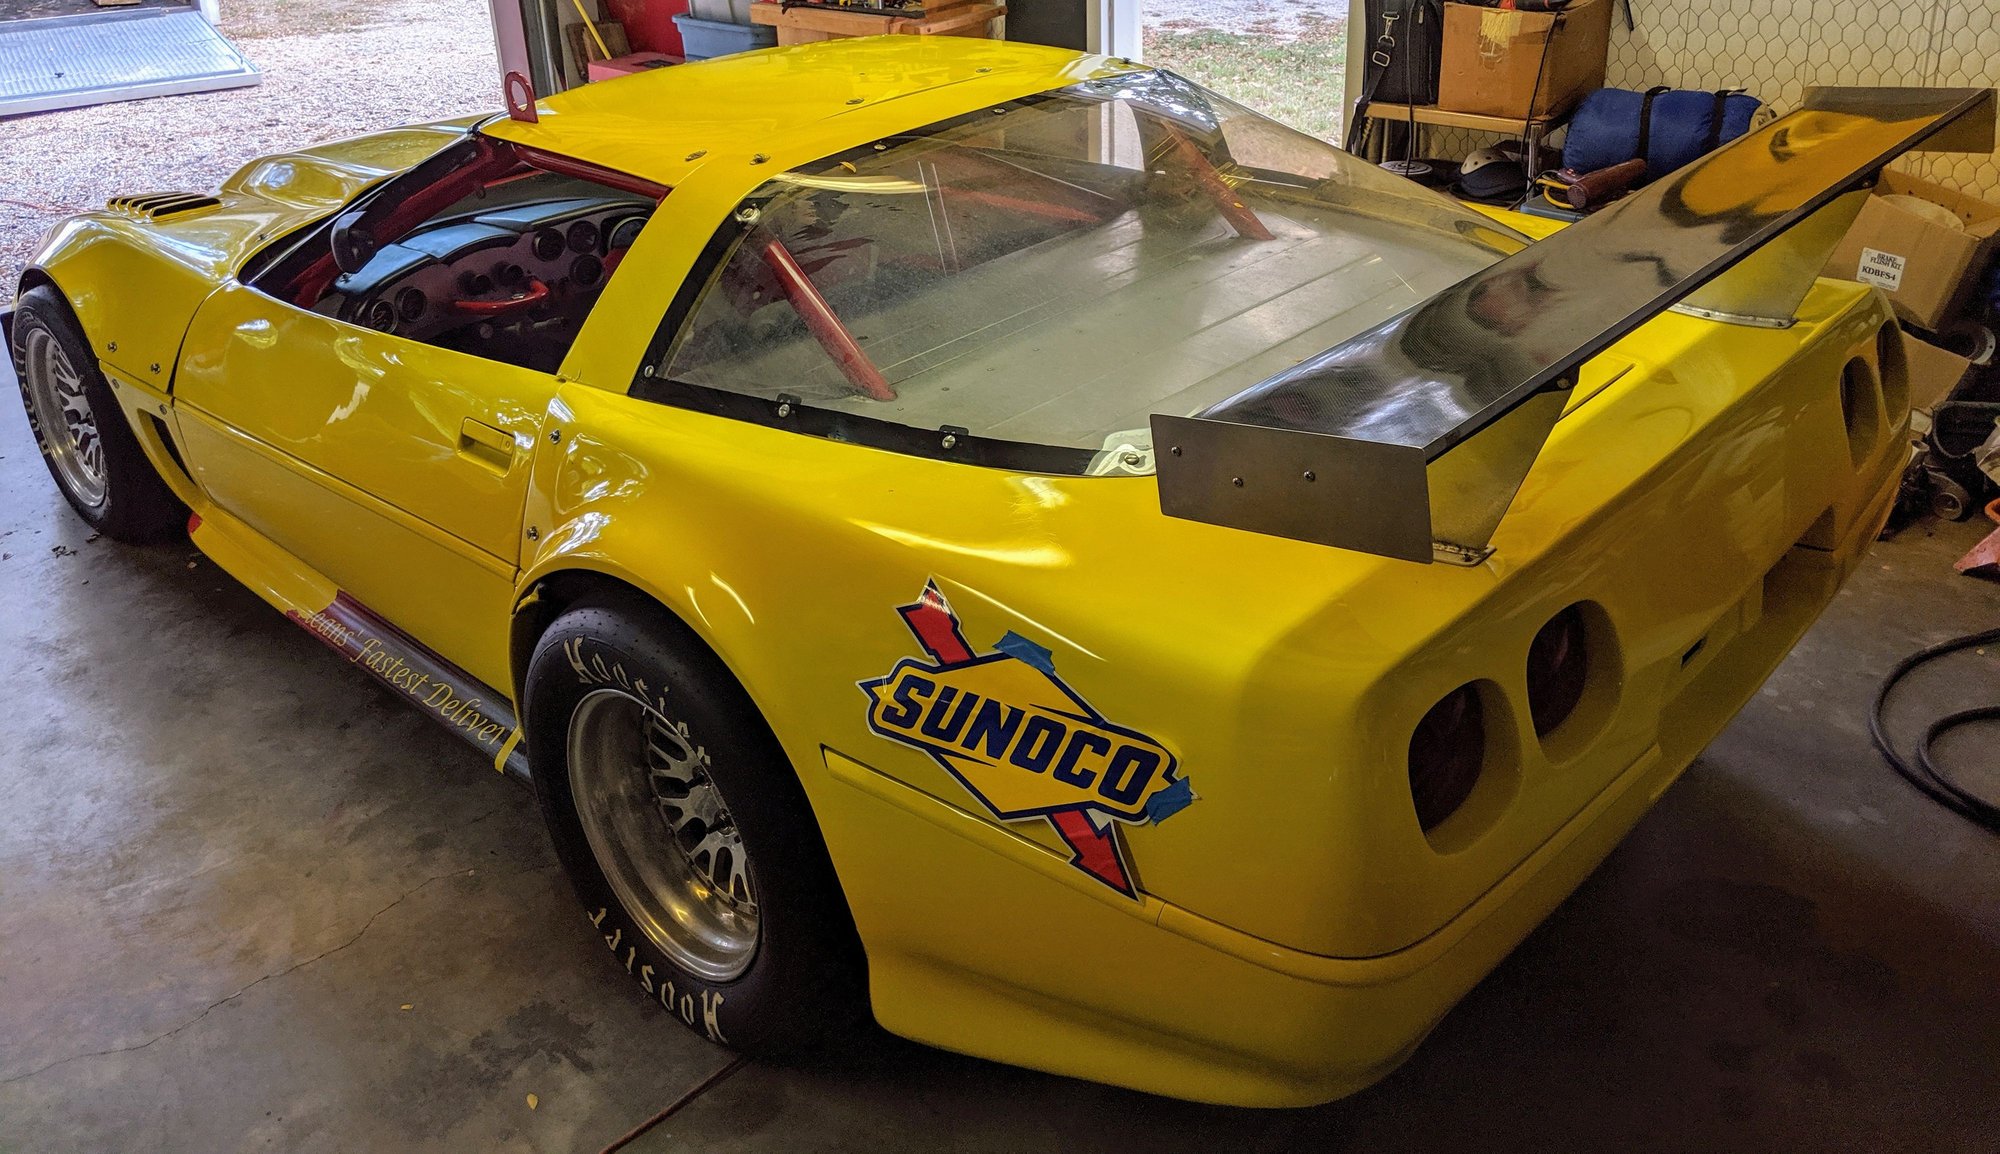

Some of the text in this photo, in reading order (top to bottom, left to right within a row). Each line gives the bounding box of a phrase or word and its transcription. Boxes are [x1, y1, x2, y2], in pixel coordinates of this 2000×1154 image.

[1870, 257, 1902, 270] FLUSH KIT
[1877, 253, 1897, 262] BRAKE
[350, 637, 430, 695] Fastest
[881, 674, 1161, 806] SUNOCO
